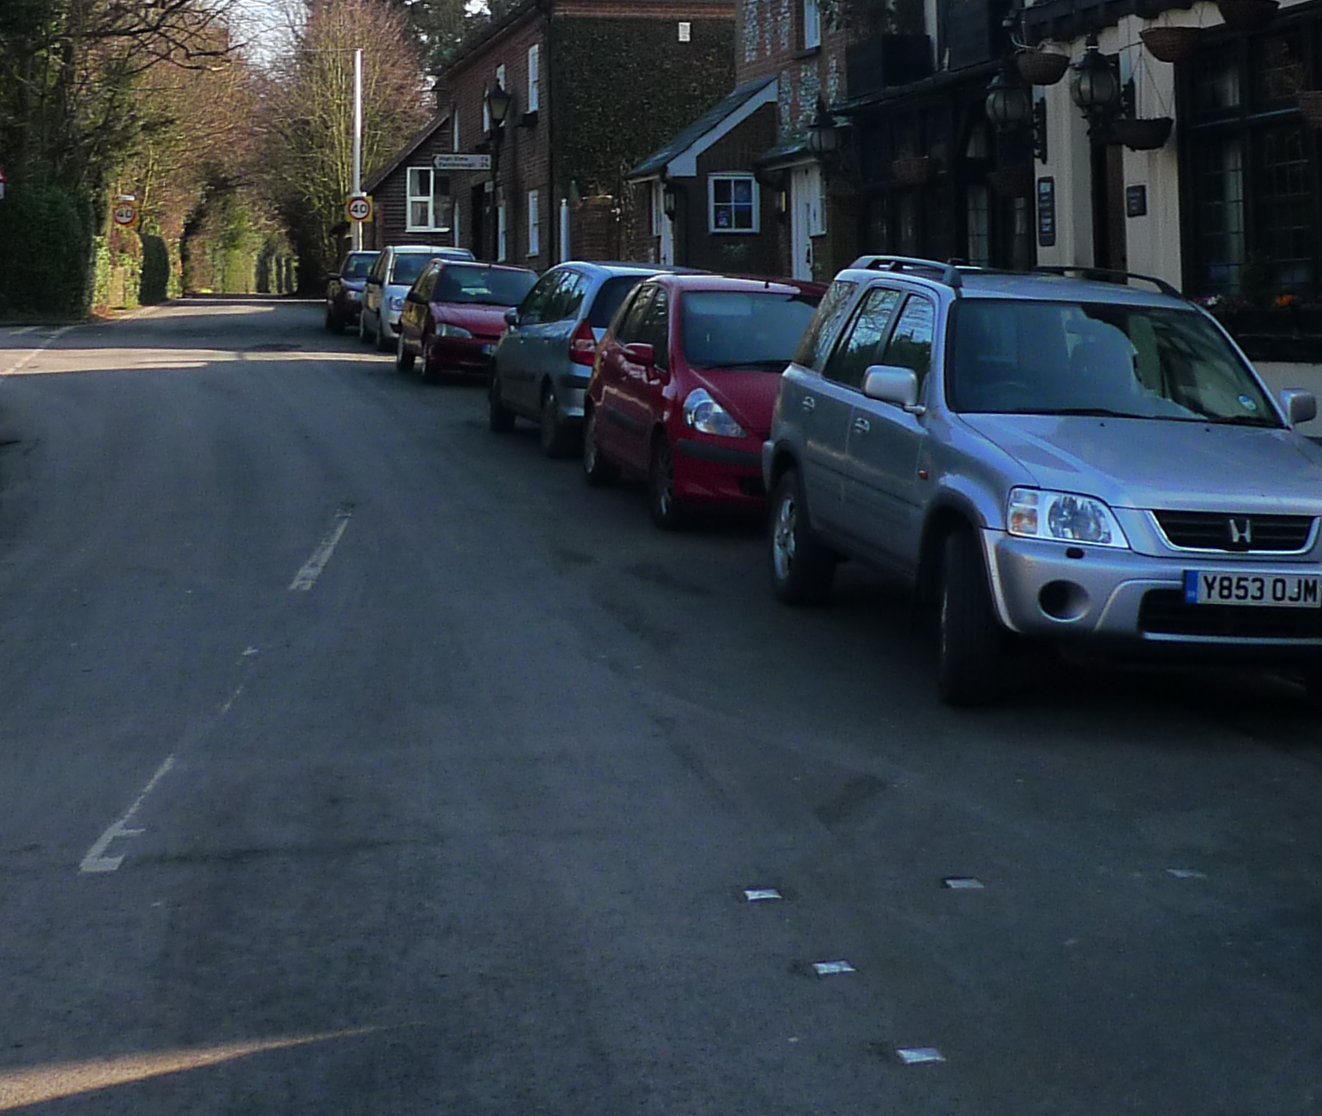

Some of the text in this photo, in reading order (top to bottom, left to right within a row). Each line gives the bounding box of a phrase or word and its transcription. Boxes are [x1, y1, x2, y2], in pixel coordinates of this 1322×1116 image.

[117, 209, 133, 218] 40
[350, 204, 367, 214] 40
[1203, 575, 1318, 603] Y853 OJM
